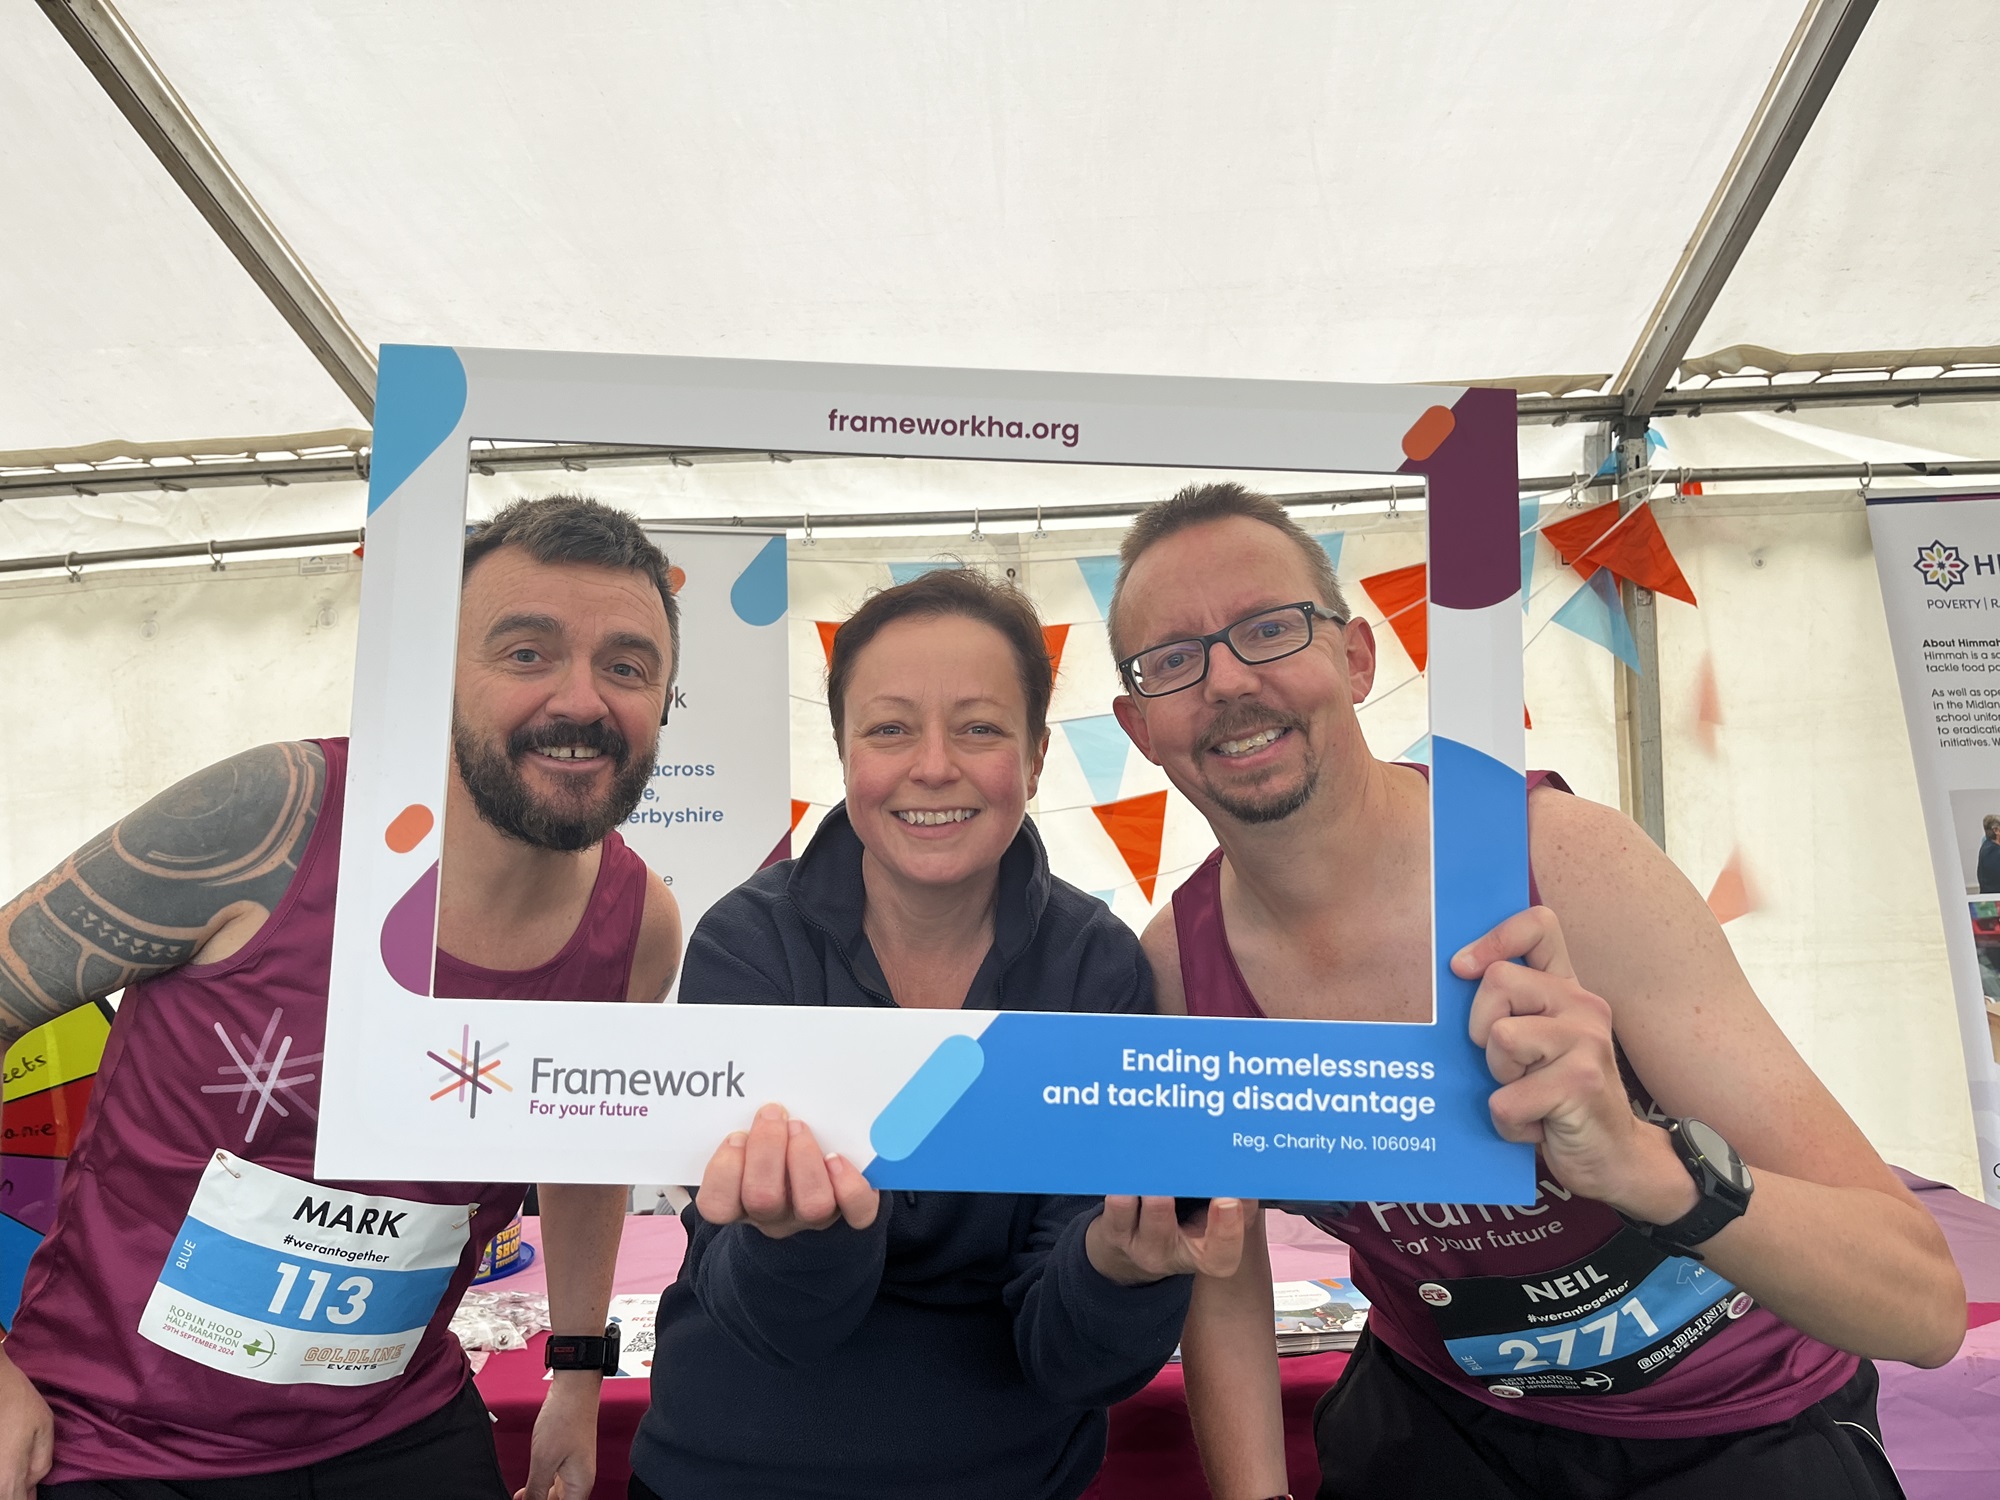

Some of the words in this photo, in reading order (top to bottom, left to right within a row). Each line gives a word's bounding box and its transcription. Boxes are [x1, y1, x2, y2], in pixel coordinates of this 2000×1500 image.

[828, 408, 1080, 448] frameworkha.org
[1973, 553, 2000, 576] H
[1926, 599, 1981, 609] POVERTY
[1922, 639, 1956, 648] About
[1924, 651, 1969, 661] Himmah
[1971, 651, 1979, 660] is
[1980, 652, 1989, 660] a
[1926, 663, 1960, 673] tackle
[1961, 663, 1985, 672] food
[1931, 688, 1945, 698] As
[1947, 687, 1967, 697] well
[1969, 688, 1981, 697] as
[1932, 700, 1944, 710] in
[1946, 700, 1964, 710] the
[1935, 712, 1972, 723] school
[1937, 725, 1950, 736] to
[1940, 737, 1991, 748] initiatives.
[627, 806, 724, 828] erbyshire
[530, 1057, 746, 1098] Framework
[1122, 1048, 1221, 1081] Ending
[1229, 1051, 1436, 1080] homelessness
[529, 1100, 555, 1116] For
[558, 1103, 595, 1119] your
[598, 1100, 649, 1117] future
[1042, 1082, 1100, 1105] and
[1107, 1083, 1225, 1116] tackling
[1232, 1086, 1436, 1122] disadvantage
[1232, 1132, 1269, 1151] Reg.
[1273, 1133, 1336, 1153] Charity
[1340, 1135, 1367, 1151] No.
[1371, 1136, 1437, 1152] 1060941
[292, 1195, 409, 1239] MARK
[283, 1233, 390, 1263] #werantogether
[1391, 1235, 1429, 1255] For
[1433, 1234, 1484, 1252] your
[1486, 1220, 1564, 1249] future
[175, 1238, 197, 1270] BLUE
[1521, 1264, 1610, 1303] NEIL
[1693, 1266, 1706, 1279] M
[267, 1262, 374, 1326] 113
[1527, 1279, 1629, 1323] #werantogether
[165, 1314, 188, 1328] HALF
[188, 1323, 240, 1348] MARATHON
[169, 1304, 206, 1327] ROBIN
[207, 1320, 243, 1339] HOOD
[1498, 1296, 1660, 1372] 2771
[1637, 1297, 1730, 1370] GOLDLINE
[162, 1323, 180, 1335] 29TH
[179, 1330, 218, 1351] SEPTEMBER
[217, 1345, 235, 1356] 2024
[304, 1343, 406, 1364] GOLDLINE
[327, 1363, 378, 1371] EVENTS
